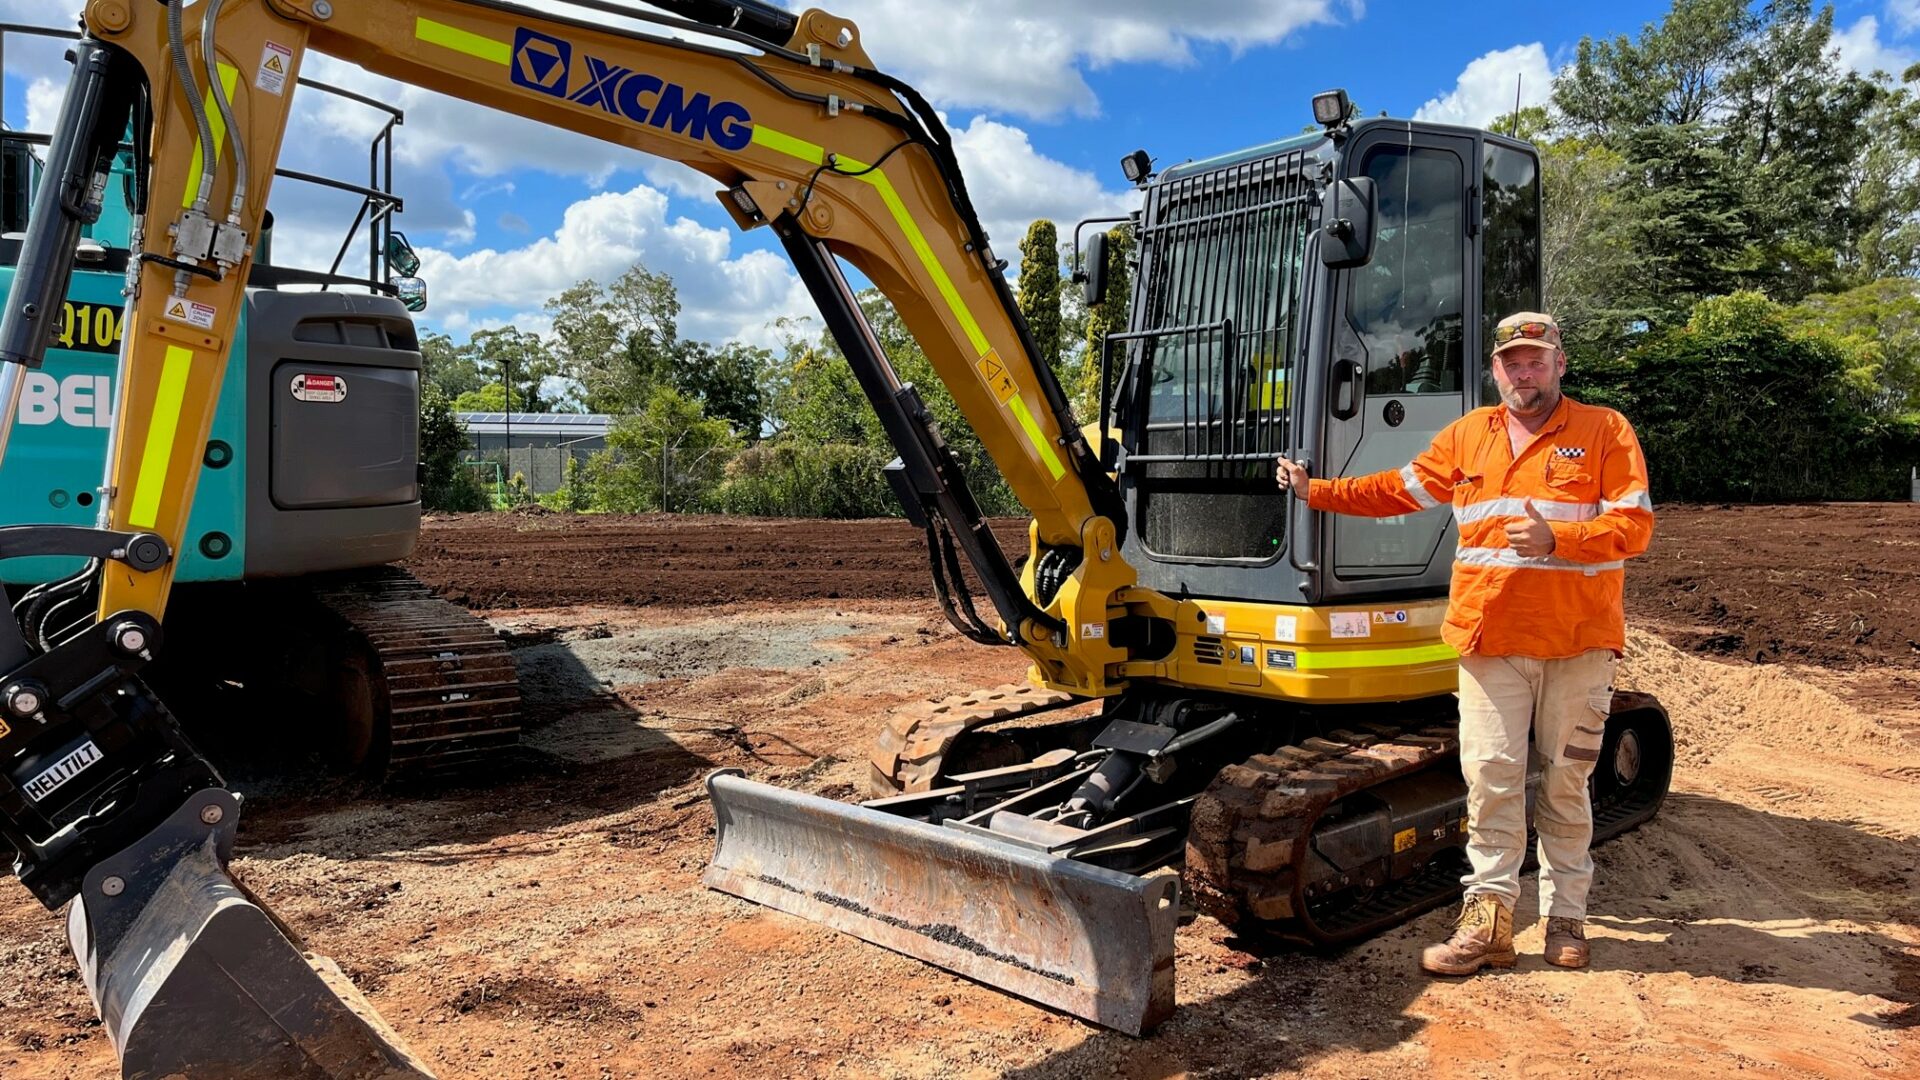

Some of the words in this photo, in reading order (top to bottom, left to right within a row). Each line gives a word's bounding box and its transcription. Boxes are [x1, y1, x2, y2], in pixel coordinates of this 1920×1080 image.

[566, 54, 753, 151] XCMG
[312, 379, 334, 387] DANGER
[26, 743, 96, 800] HELITILT
